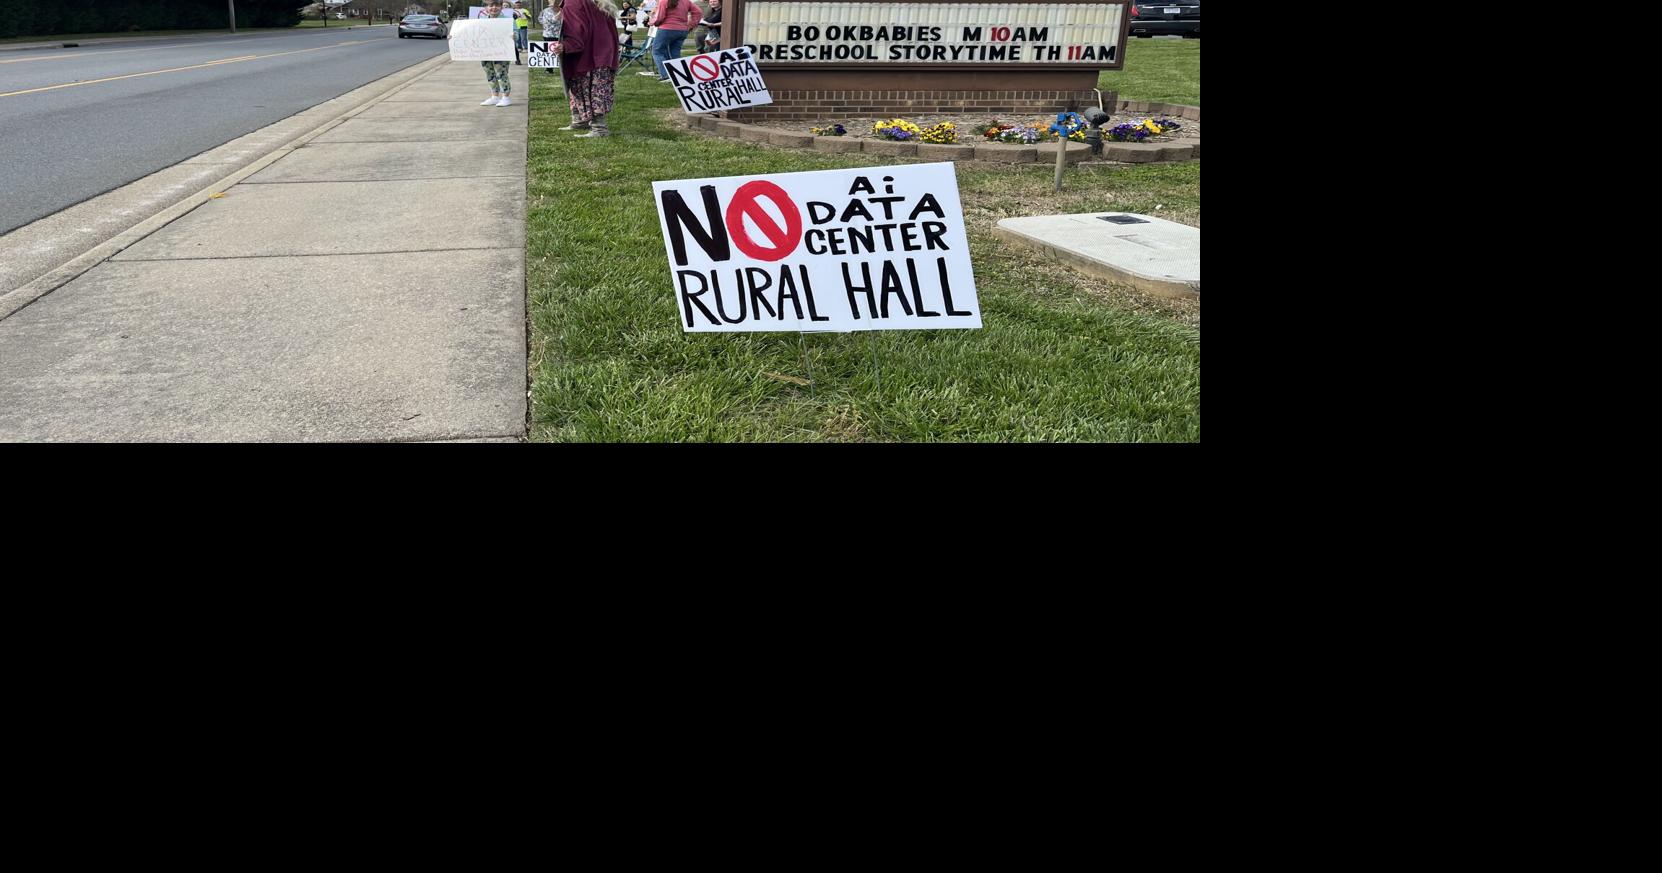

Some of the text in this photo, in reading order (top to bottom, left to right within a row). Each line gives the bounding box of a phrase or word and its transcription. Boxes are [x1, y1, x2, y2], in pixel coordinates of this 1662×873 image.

[963, 26, 982, 42] M
[991, 26, 1049, 42] 10AM
[889, 44, 1021, 61] STORYTIME
[1033, 45, 1061, 61] TH
[1067, 45, 1117, 61] 11AM
[720, 60, 758, 79] DATA
[678, 77, 767, 112] RURAL HALL
[698, 78, 734, 91] CENTER
[806, 192, 946, 225] DATA
[804, 220, 950, 256] CENTER
[677, 256, 973, 328] RURAL HALL
